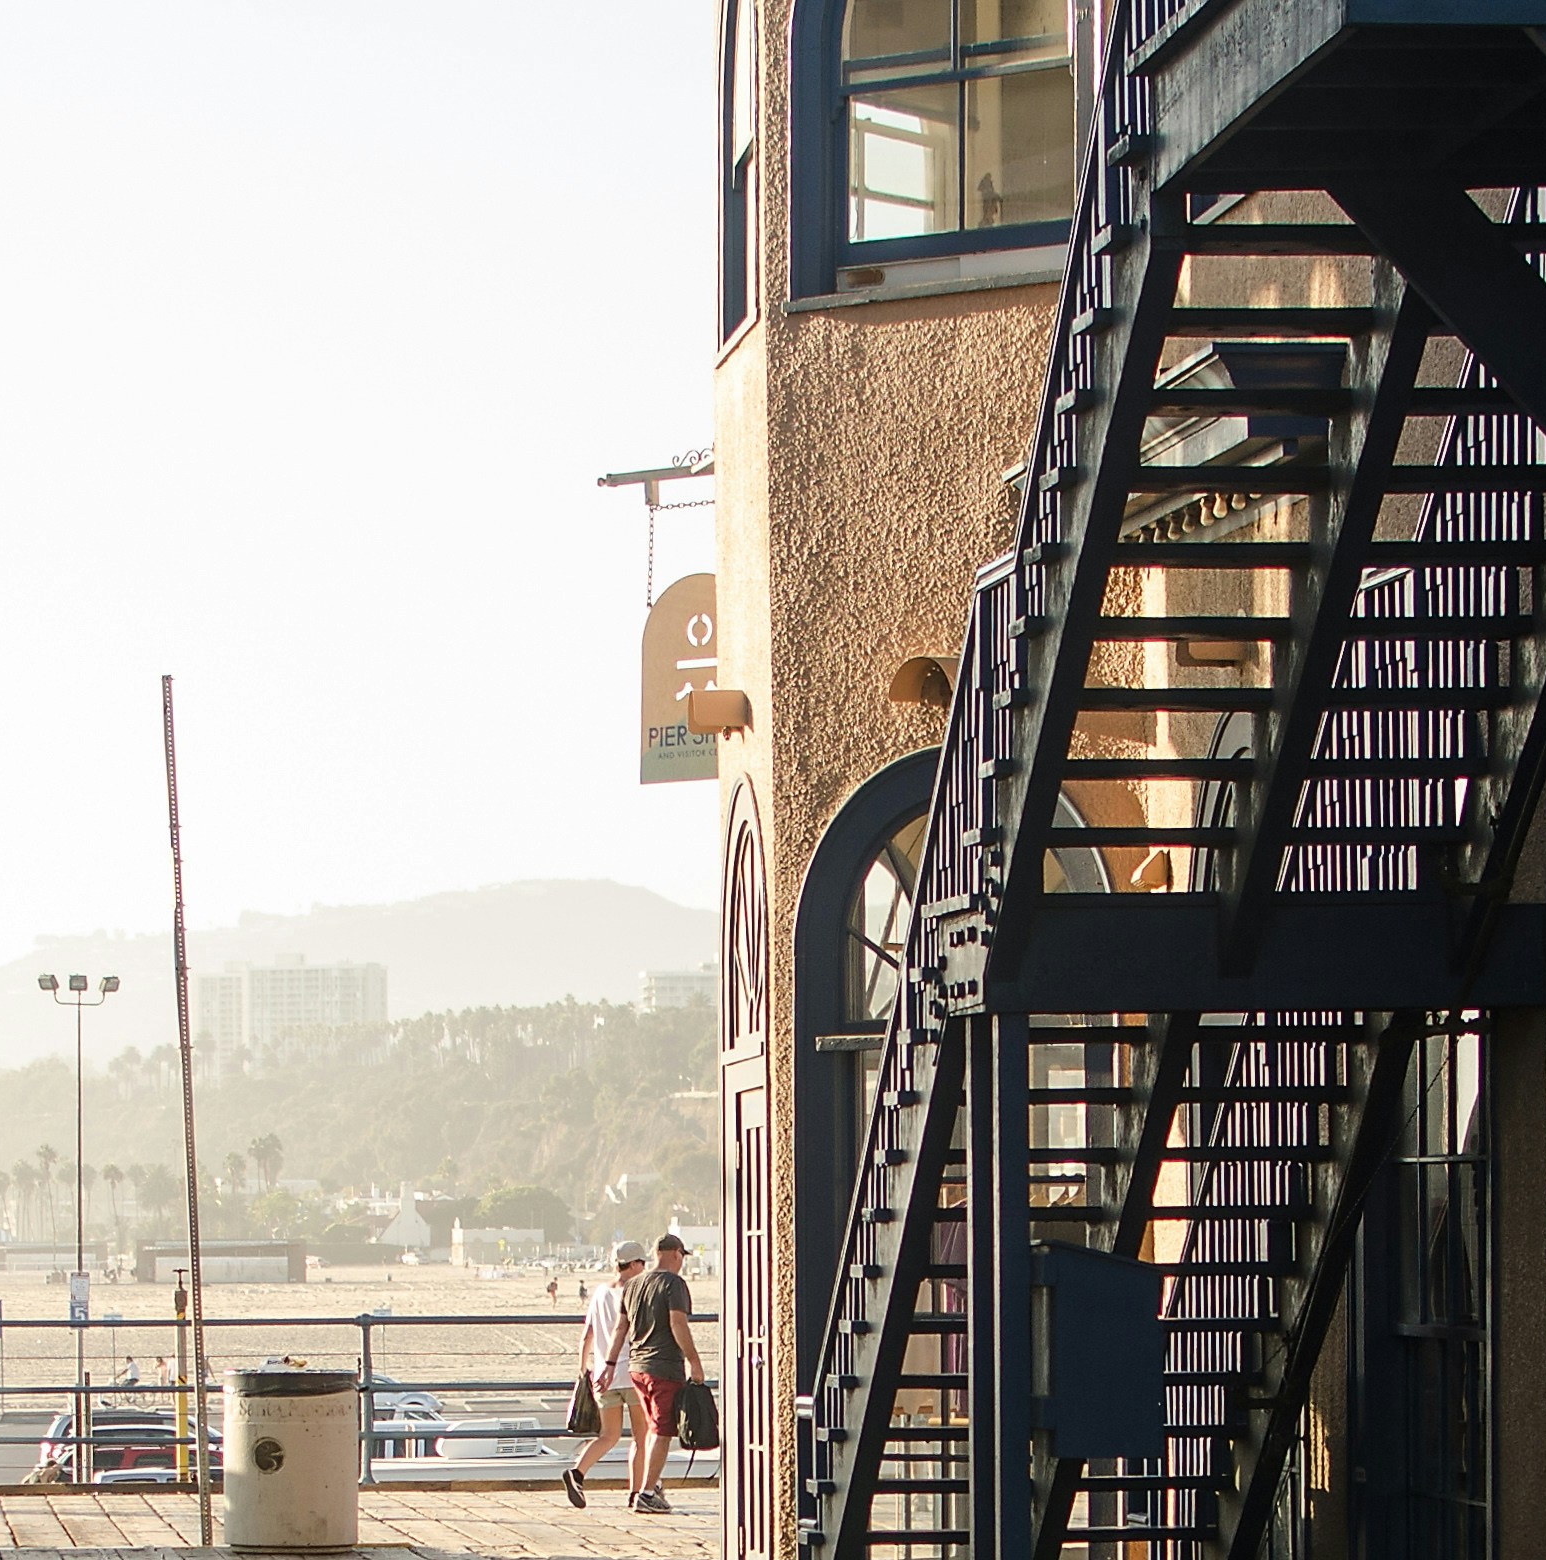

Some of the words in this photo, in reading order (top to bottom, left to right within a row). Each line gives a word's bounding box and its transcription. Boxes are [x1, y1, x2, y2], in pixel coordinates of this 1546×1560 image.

[649, 726, 687, 748] PIER
[659, 751, 675, 759] AND
[677, 749, 705, 758] VISITOR
